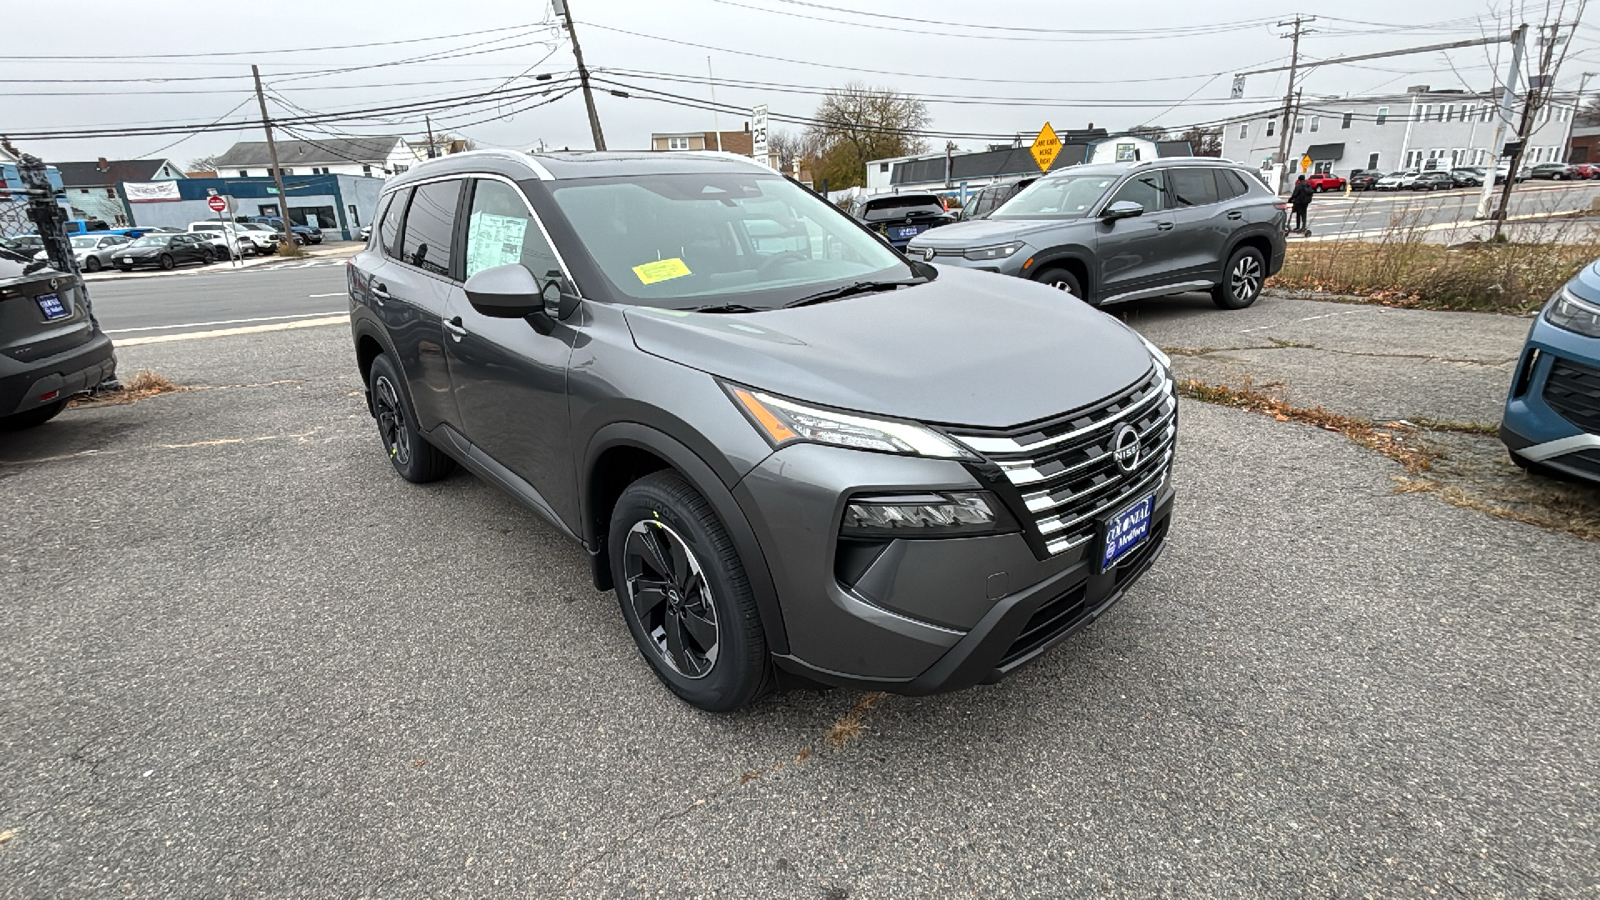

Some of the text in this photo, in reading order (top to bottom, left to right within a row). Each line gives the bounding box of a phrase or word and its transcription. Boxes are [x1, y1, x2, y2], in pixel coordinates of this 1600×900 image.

[754, 128, 767, 144] 25
[1106, 503, 1151, 544] COLONIAL
[1118, 521, 1147, 549] Medford
